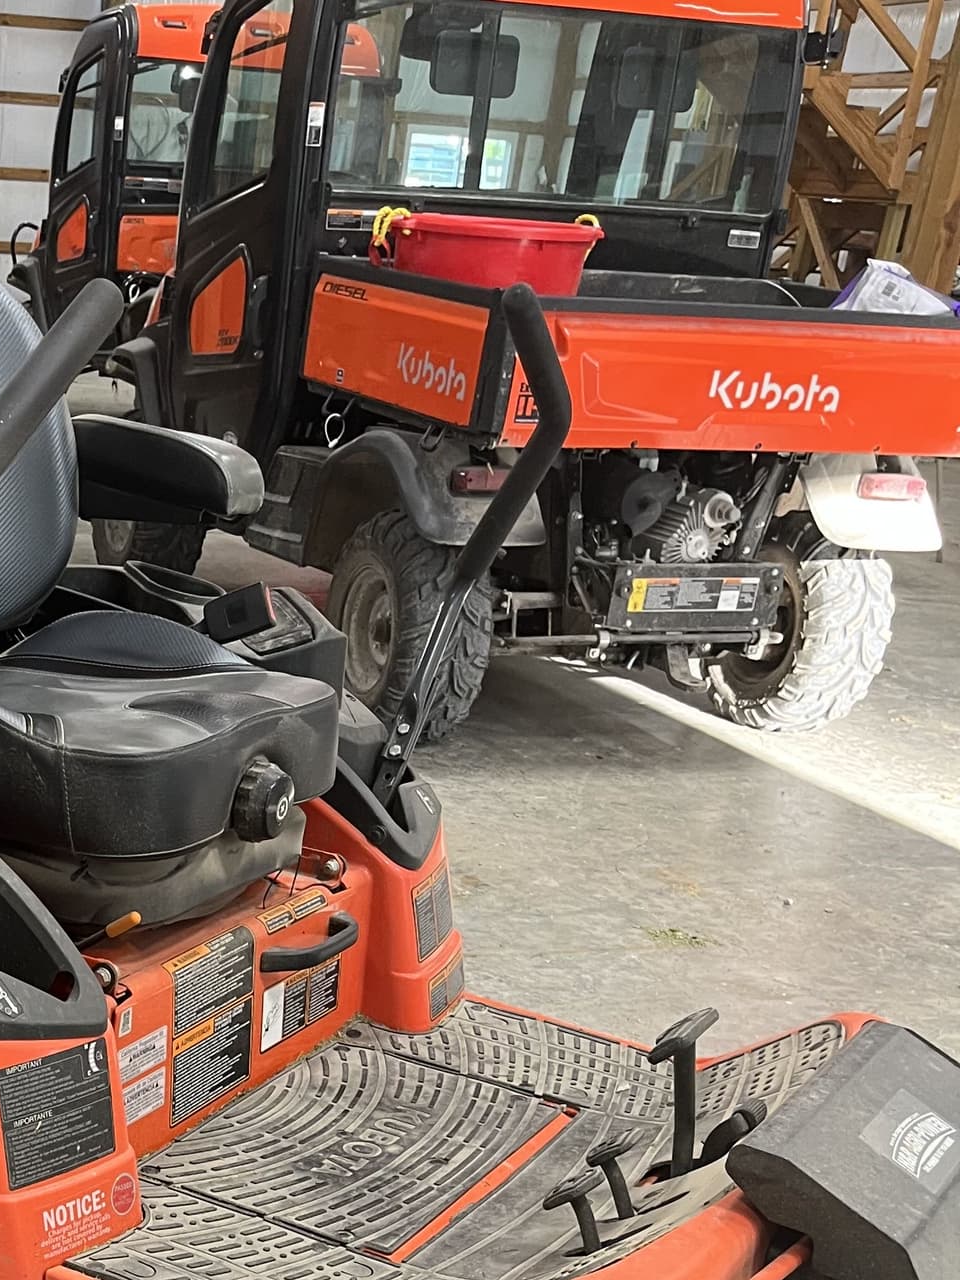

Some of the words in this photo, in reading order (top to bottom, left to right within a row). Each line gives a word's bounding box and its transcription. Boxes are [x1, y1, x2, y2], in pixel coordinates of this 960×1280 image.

[322, 280, 369, 301] DIESEL
[396, 342, 467, 402] Kubota
[708, 369, 840, 413] Kubota
[5, 1058, 43, 1076] IMPORTANT
[13, 1109, 54, 1129] IMPORTANTE
[310, 1105, 432, 1177] KUBOTA
[42, 1188, 107, 1233] NOTICE:
